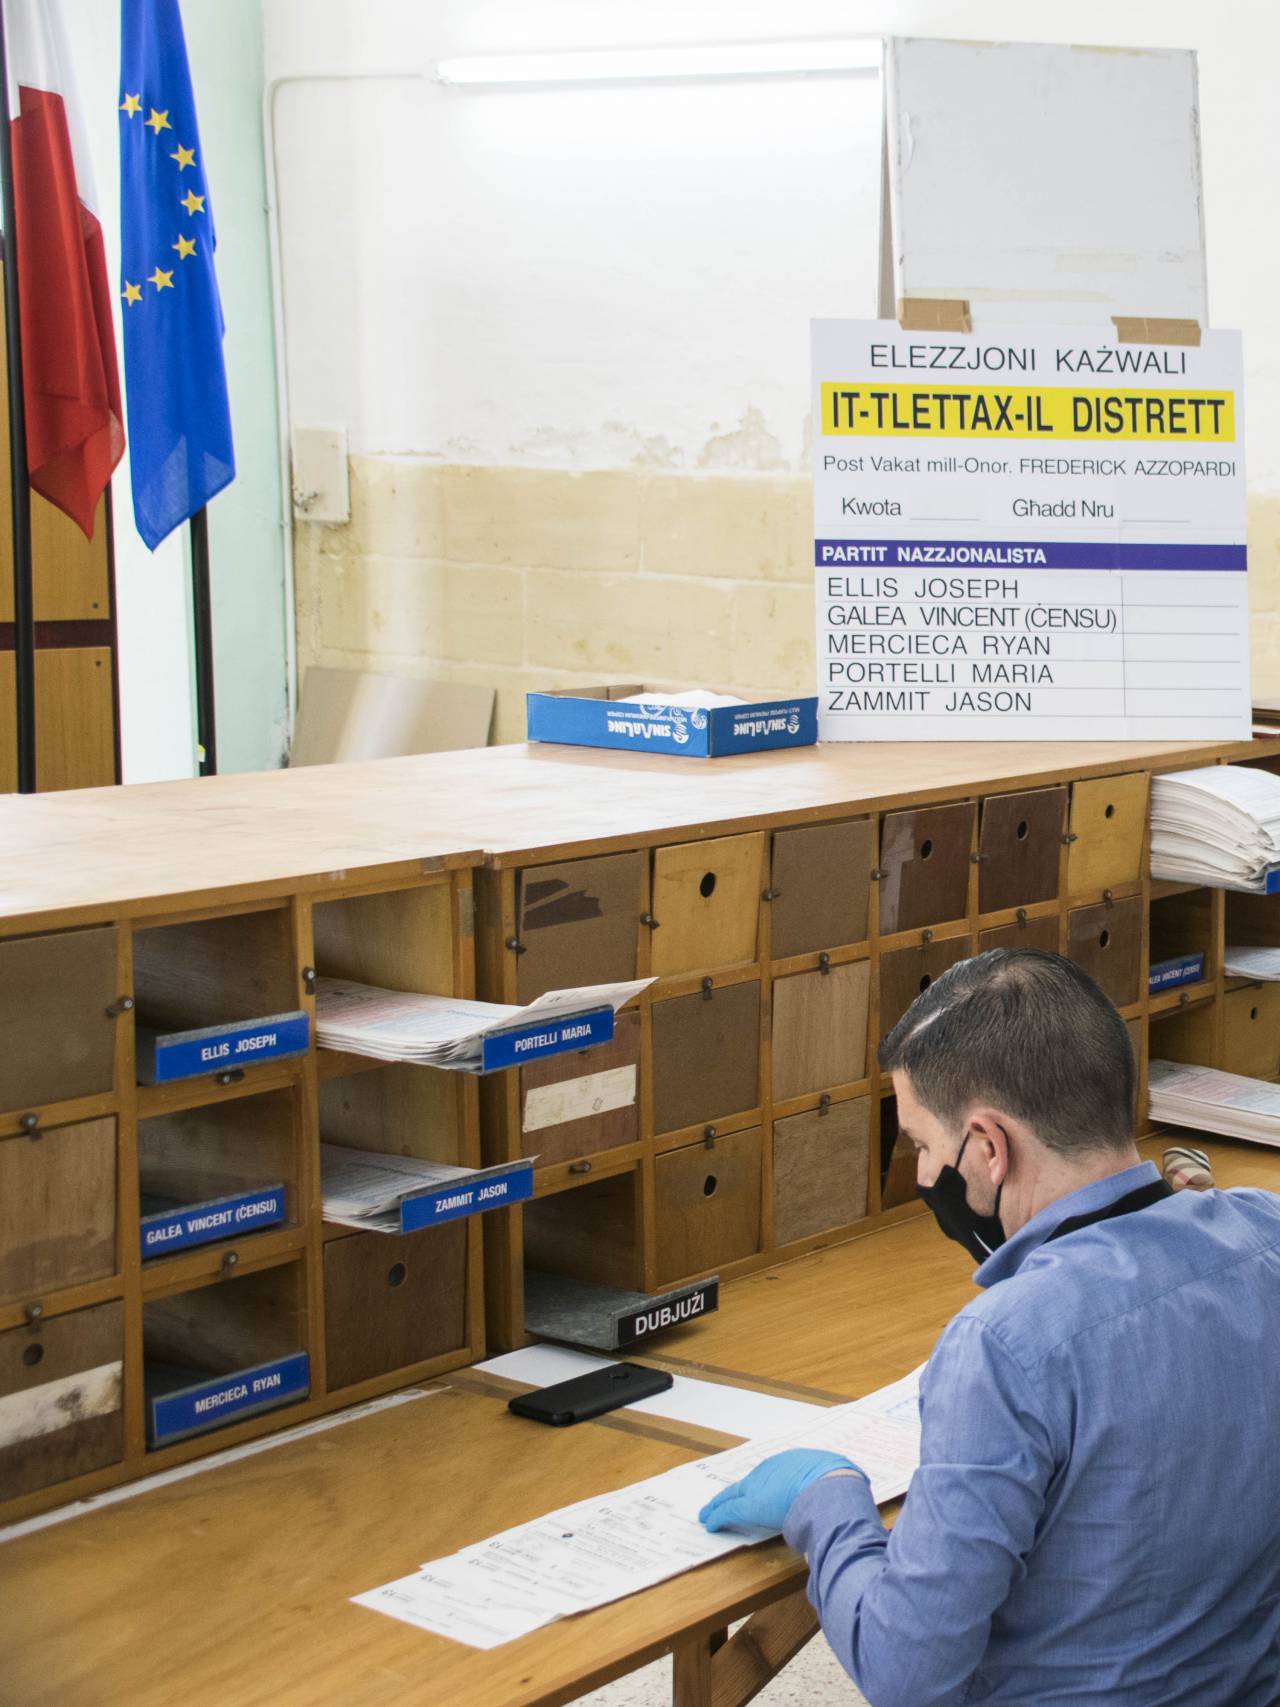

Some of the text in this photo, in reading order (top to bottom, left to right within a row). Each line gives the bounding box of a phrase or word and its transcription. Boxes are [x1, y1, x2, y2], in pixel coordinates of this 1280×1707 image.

[870, 344, 1186, 375] ELEZZJONI KAŻWALI
[832, 391, 1225, 435] IT-TLETTAX-IL DISTRETT
[823, 455, 1236, 477] Post Vakat mill-Onor. FREDERICK AZZOPARDI
[842, 498, 902, 517] Kwota
[1081, 500, 1114, 519] Nru
[822, 546, 1047, 565] PARTIT NAZZJONALISTA
[827, 577, 1019, 600] ELLIS JOSEPH
[827, 603, 1117, 633] GALEA VINCENT (ĊENSU)
[827, 634, 1051, 656] MERCIECA RYAN
[828, 662, 1054, 684] PORTELLI MARIA
[828, 691, 1032, 712] ZAMMIT JASON
[201, 1033, 277, 1062] ELLIS JOSEPH
[514, 1023, 592, 1053] PORTELLI MARIA
[435, 1182, 508, 1214] ZAMMIT JASON
[147, 1223, 183, 1244] GALEA
[187, 1209, 233, 1233] VINCENT
[635, 1291, 706, 1336] DUBJUŻI
[195, 1373, 281, 1414] MERCIECA RYAN
